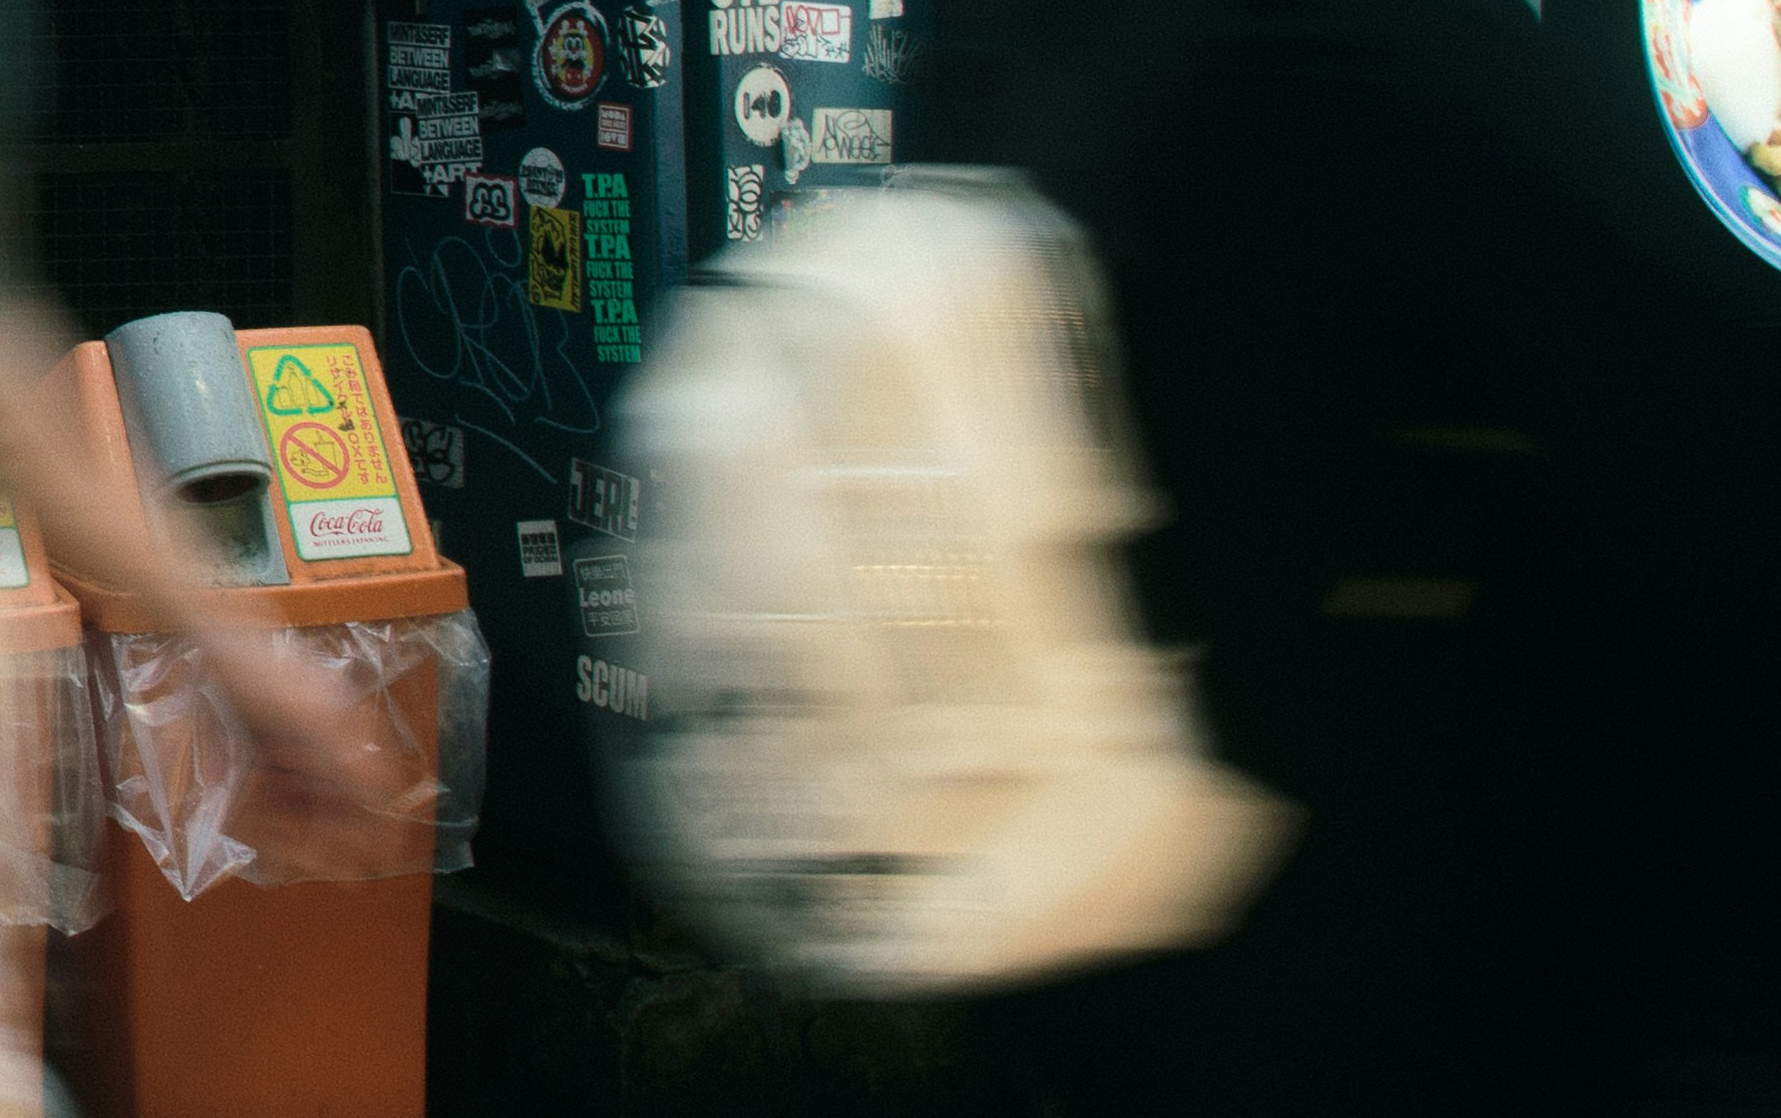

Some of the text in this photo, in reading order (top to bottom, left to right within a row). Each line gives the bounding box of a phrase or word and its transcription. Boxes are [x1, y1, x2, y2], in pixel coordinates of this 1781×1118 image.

[709, 5, 781, 56] RUNS
[390, 45, 449, 67] BETWEEN
[389, 67, 450, 90] LANGUAGE
[418, 117, 480, 139] BETWEEN
[420, 137, 482, 162] LANGUAGE
[582, 173, 628, 199] T.P.A
[583, 200, 631, 218] FUCK THE
[587, 219, 631, 234] SYSTEM
[584, 234, 631, 259] T.P.A
[586, 260, 634, 280] FUCK THE
[589, 280, 633, 299] SYSTEM
[591, 298, 638, 324] T.P.A
[594, 325, 642, 344] FUCK THE
[597, 345, 641, 363] SYSTEM
[310, 508, 384, 537] Coca-Cola
[579, 587, 636, 608] Leone
[576, 654, 648, 721] SCUM
